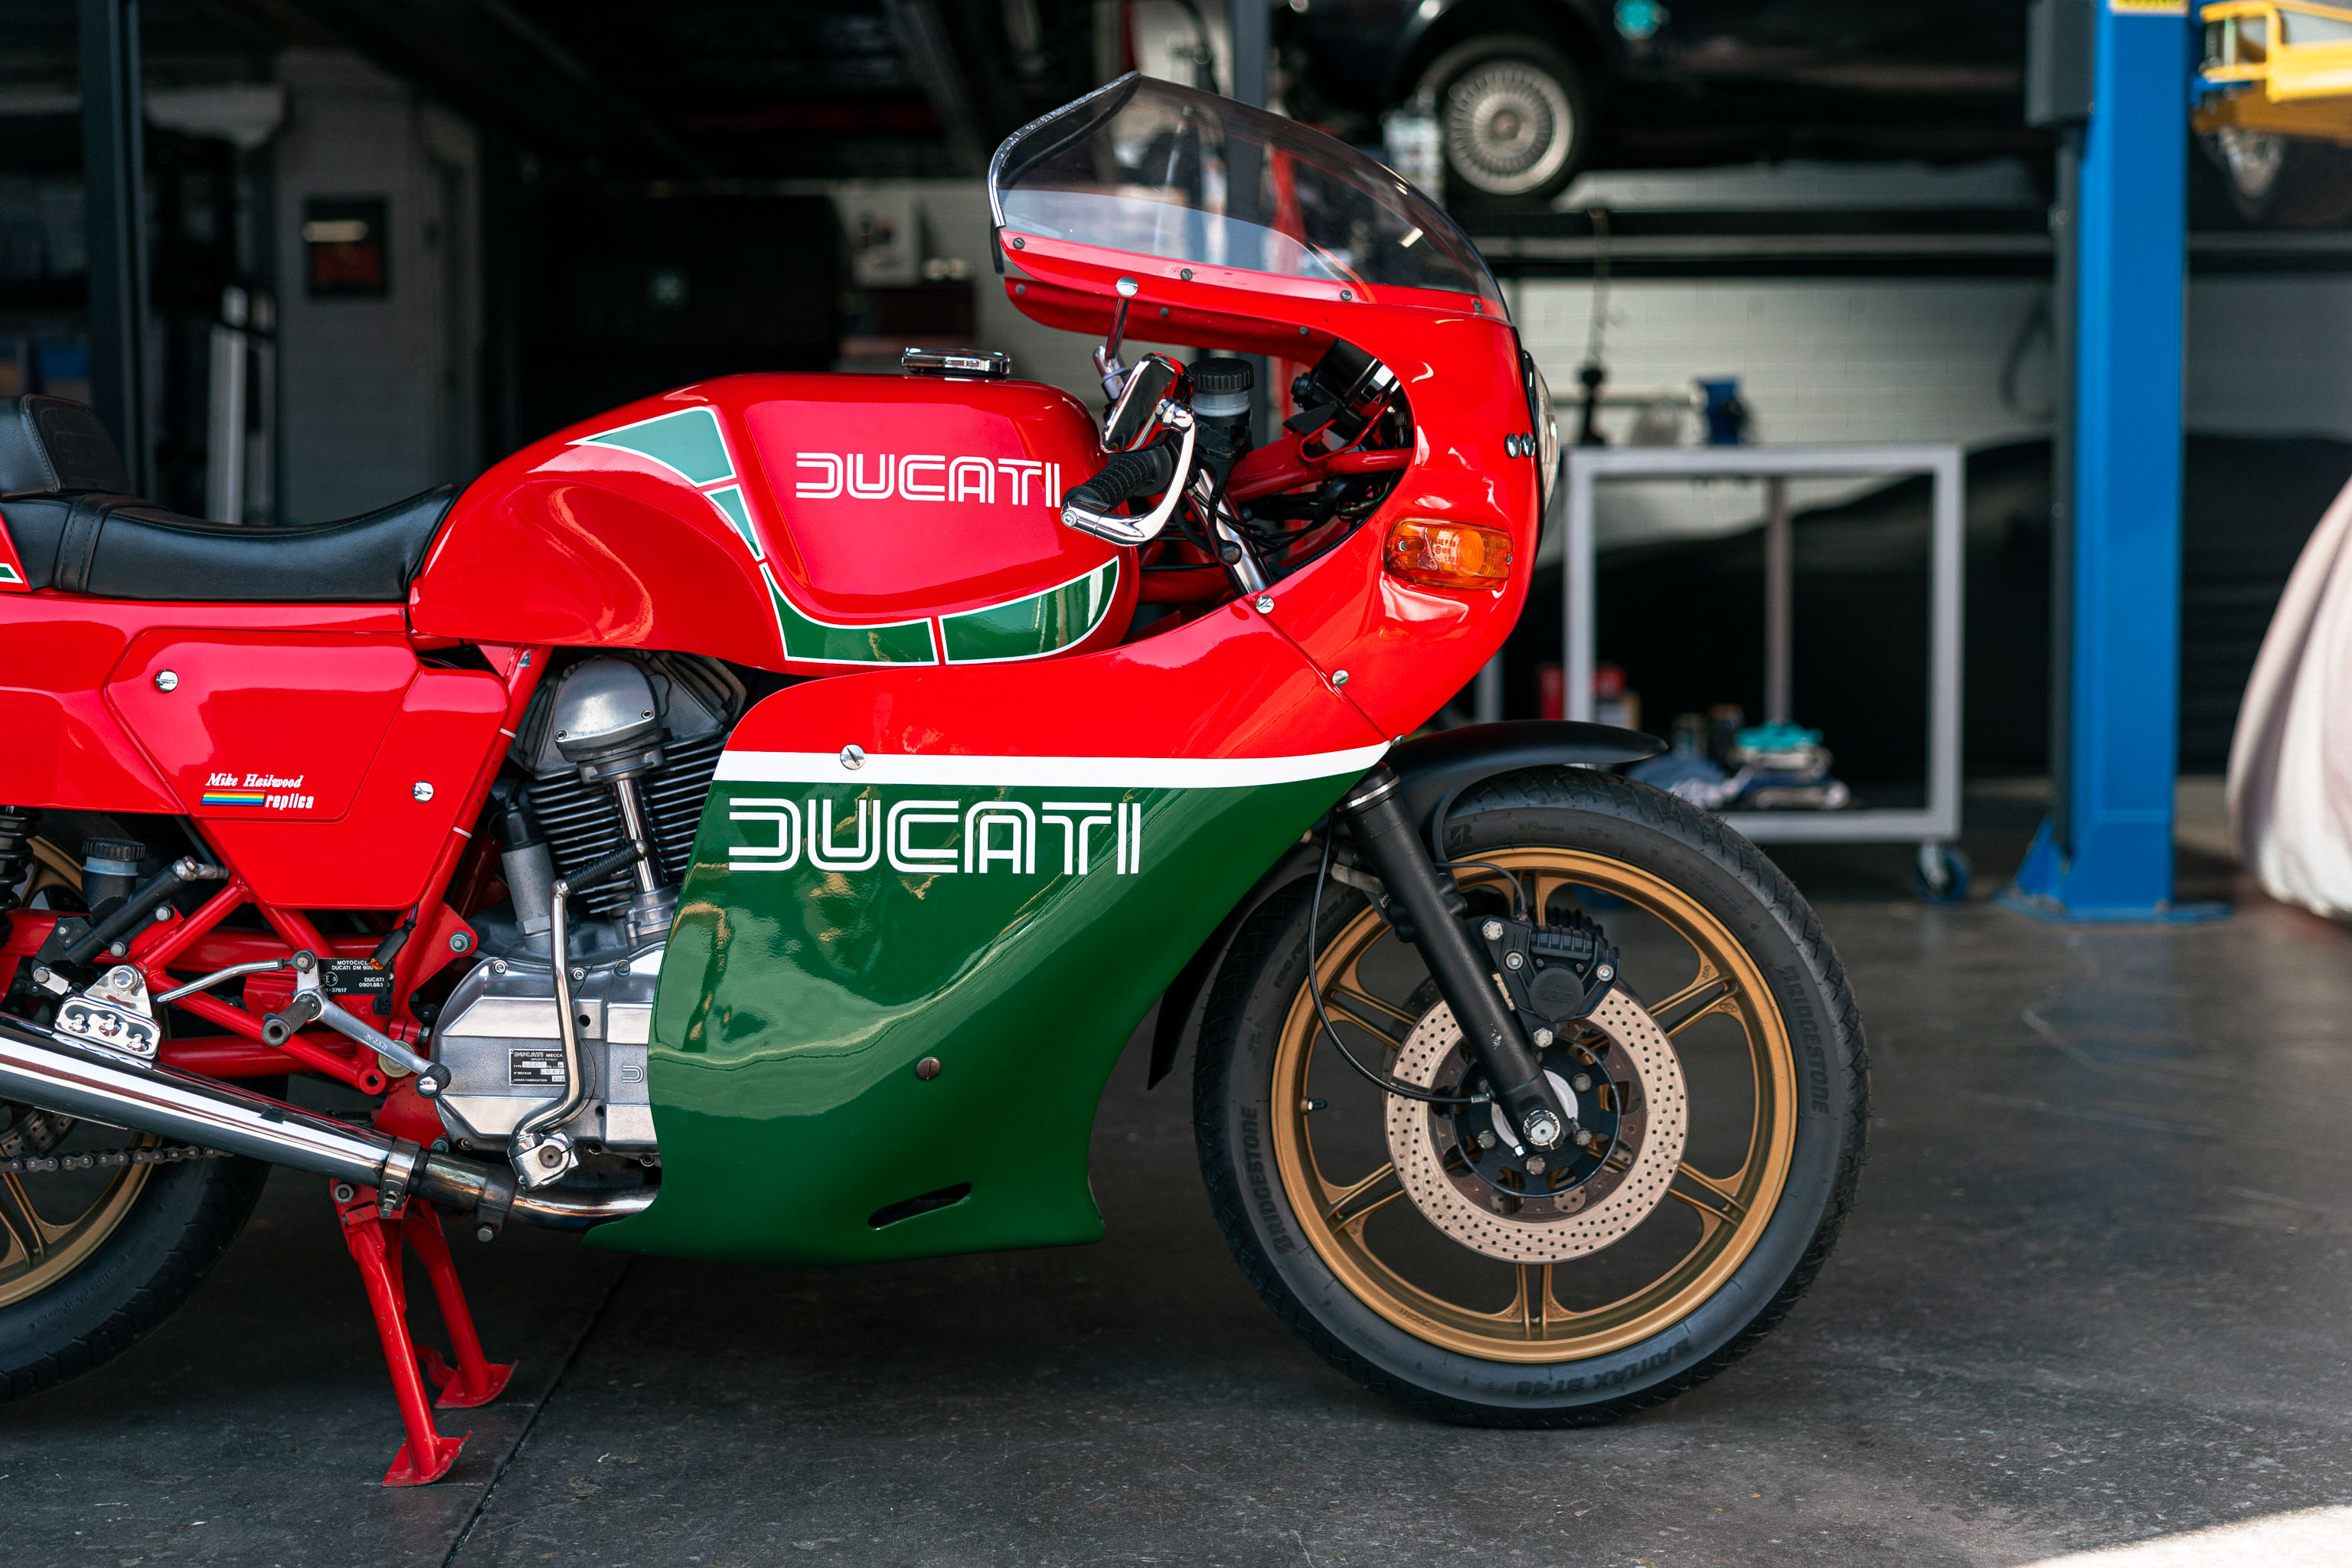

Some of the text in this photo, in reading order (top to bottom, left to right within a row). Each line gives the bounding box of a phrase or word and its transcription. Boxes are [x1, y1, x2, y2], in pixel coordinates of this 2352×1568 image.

[795, 452, 1061, 508] DUCATI
[205, 773, 304, 788] Mike Hailwood
[265, 793, 315, 810] replica
[729, 798, 1142, 874] DUCATI
[1240, 1107, 1297, 1253] BRIDGESTONE
